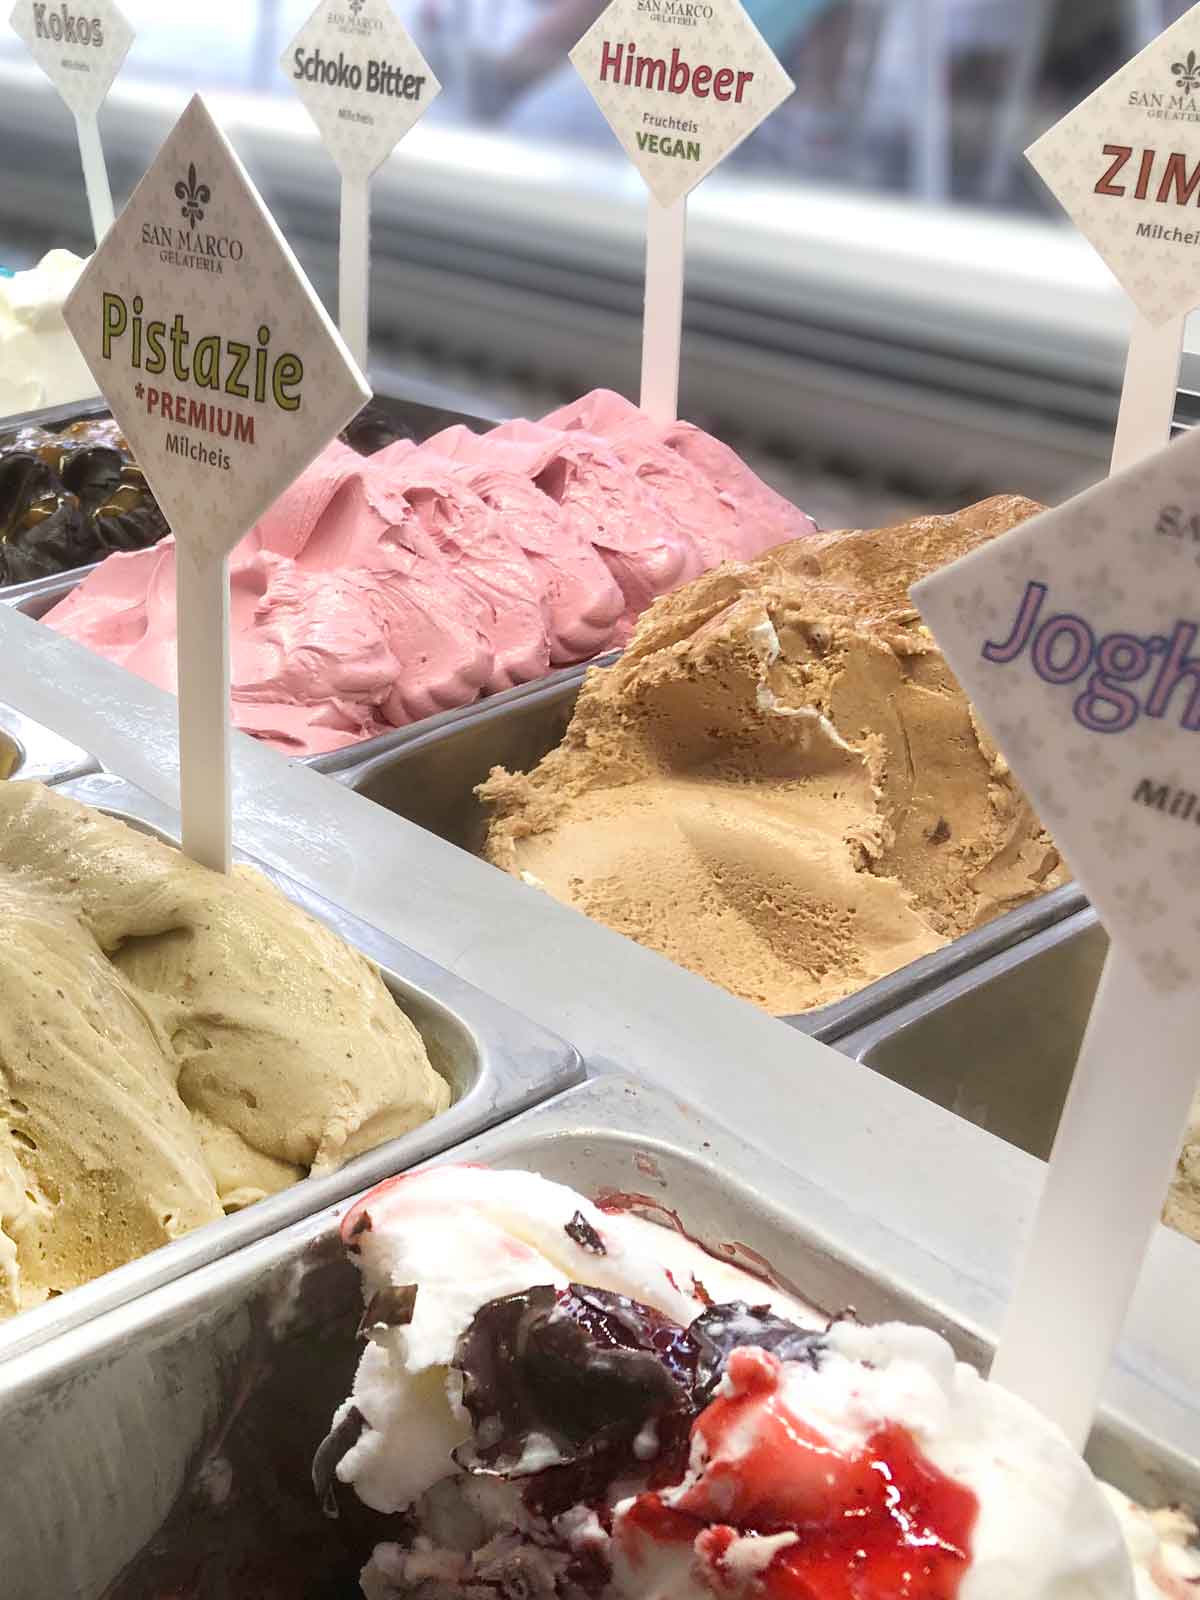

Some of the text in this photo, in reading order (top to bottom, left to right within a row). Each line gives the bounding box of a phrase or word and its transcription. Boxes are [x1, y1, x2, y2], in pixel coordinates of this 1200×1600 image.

[33, 2, 104, 47] Kokos
[637, 0, 713, 19] SAN MARCO
[649, 13, 697, 26] GELATERIA
[293, 47, 426, 101] Schoko Bitter
[600, 41, 754, 104] Himbeer
[1128, 91, 1165, 108] SAN
[642, 112, 699, 134] Fruchteis
[636, 131, 701, 161] VEGAN
[1094, 144, 1200, 209] ZIM
[141, 223, 243, 261] SAN MARCO
[159, 250, 224, 274] GELATERIA
[102, 292, 304, 412] Pistazie
[165, 432, 231, 471] Milcheis
